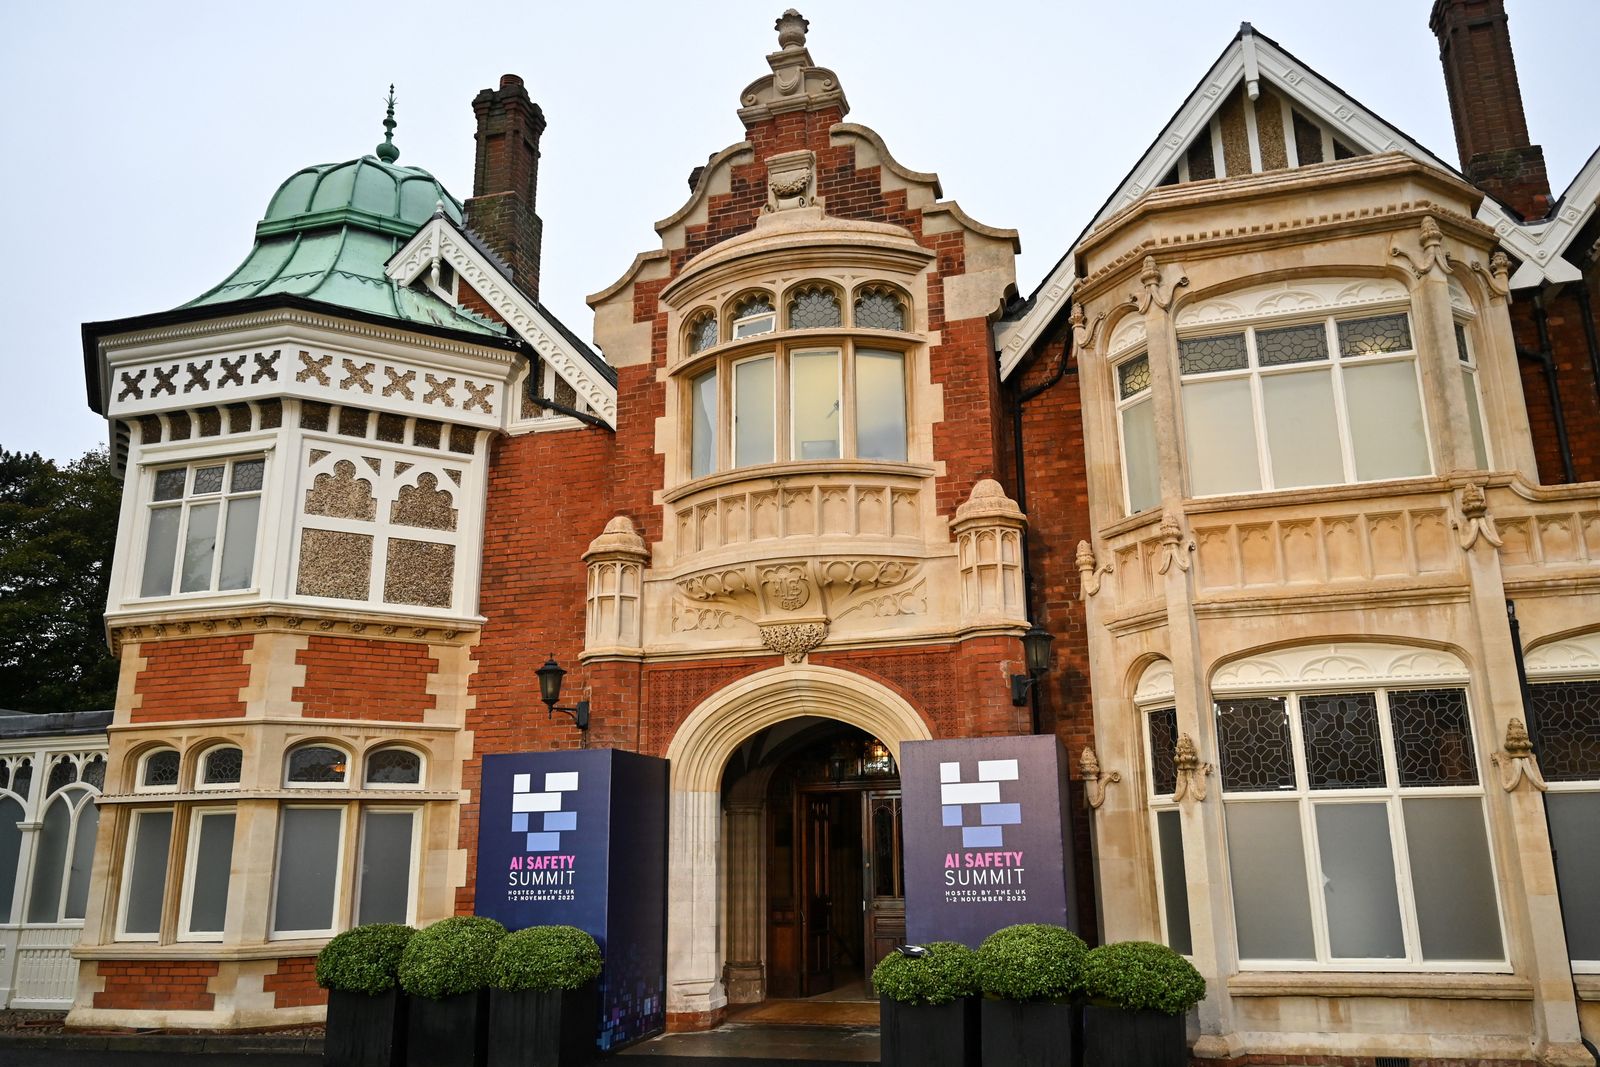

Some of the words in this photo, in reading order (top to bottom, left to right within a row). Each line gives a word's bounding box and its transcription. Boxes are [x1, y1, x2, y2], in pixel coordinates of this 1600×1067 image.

[509, 856, 524, 870] AI
[526, 855, 576, 870] SAFETY
[945, 853, 960, 869] AI
[964, 851, 1024, 868] SAFETY
[508, 870, 576, 886] SUMMIT
[944, 868, 1025, 886] SUMMIT
